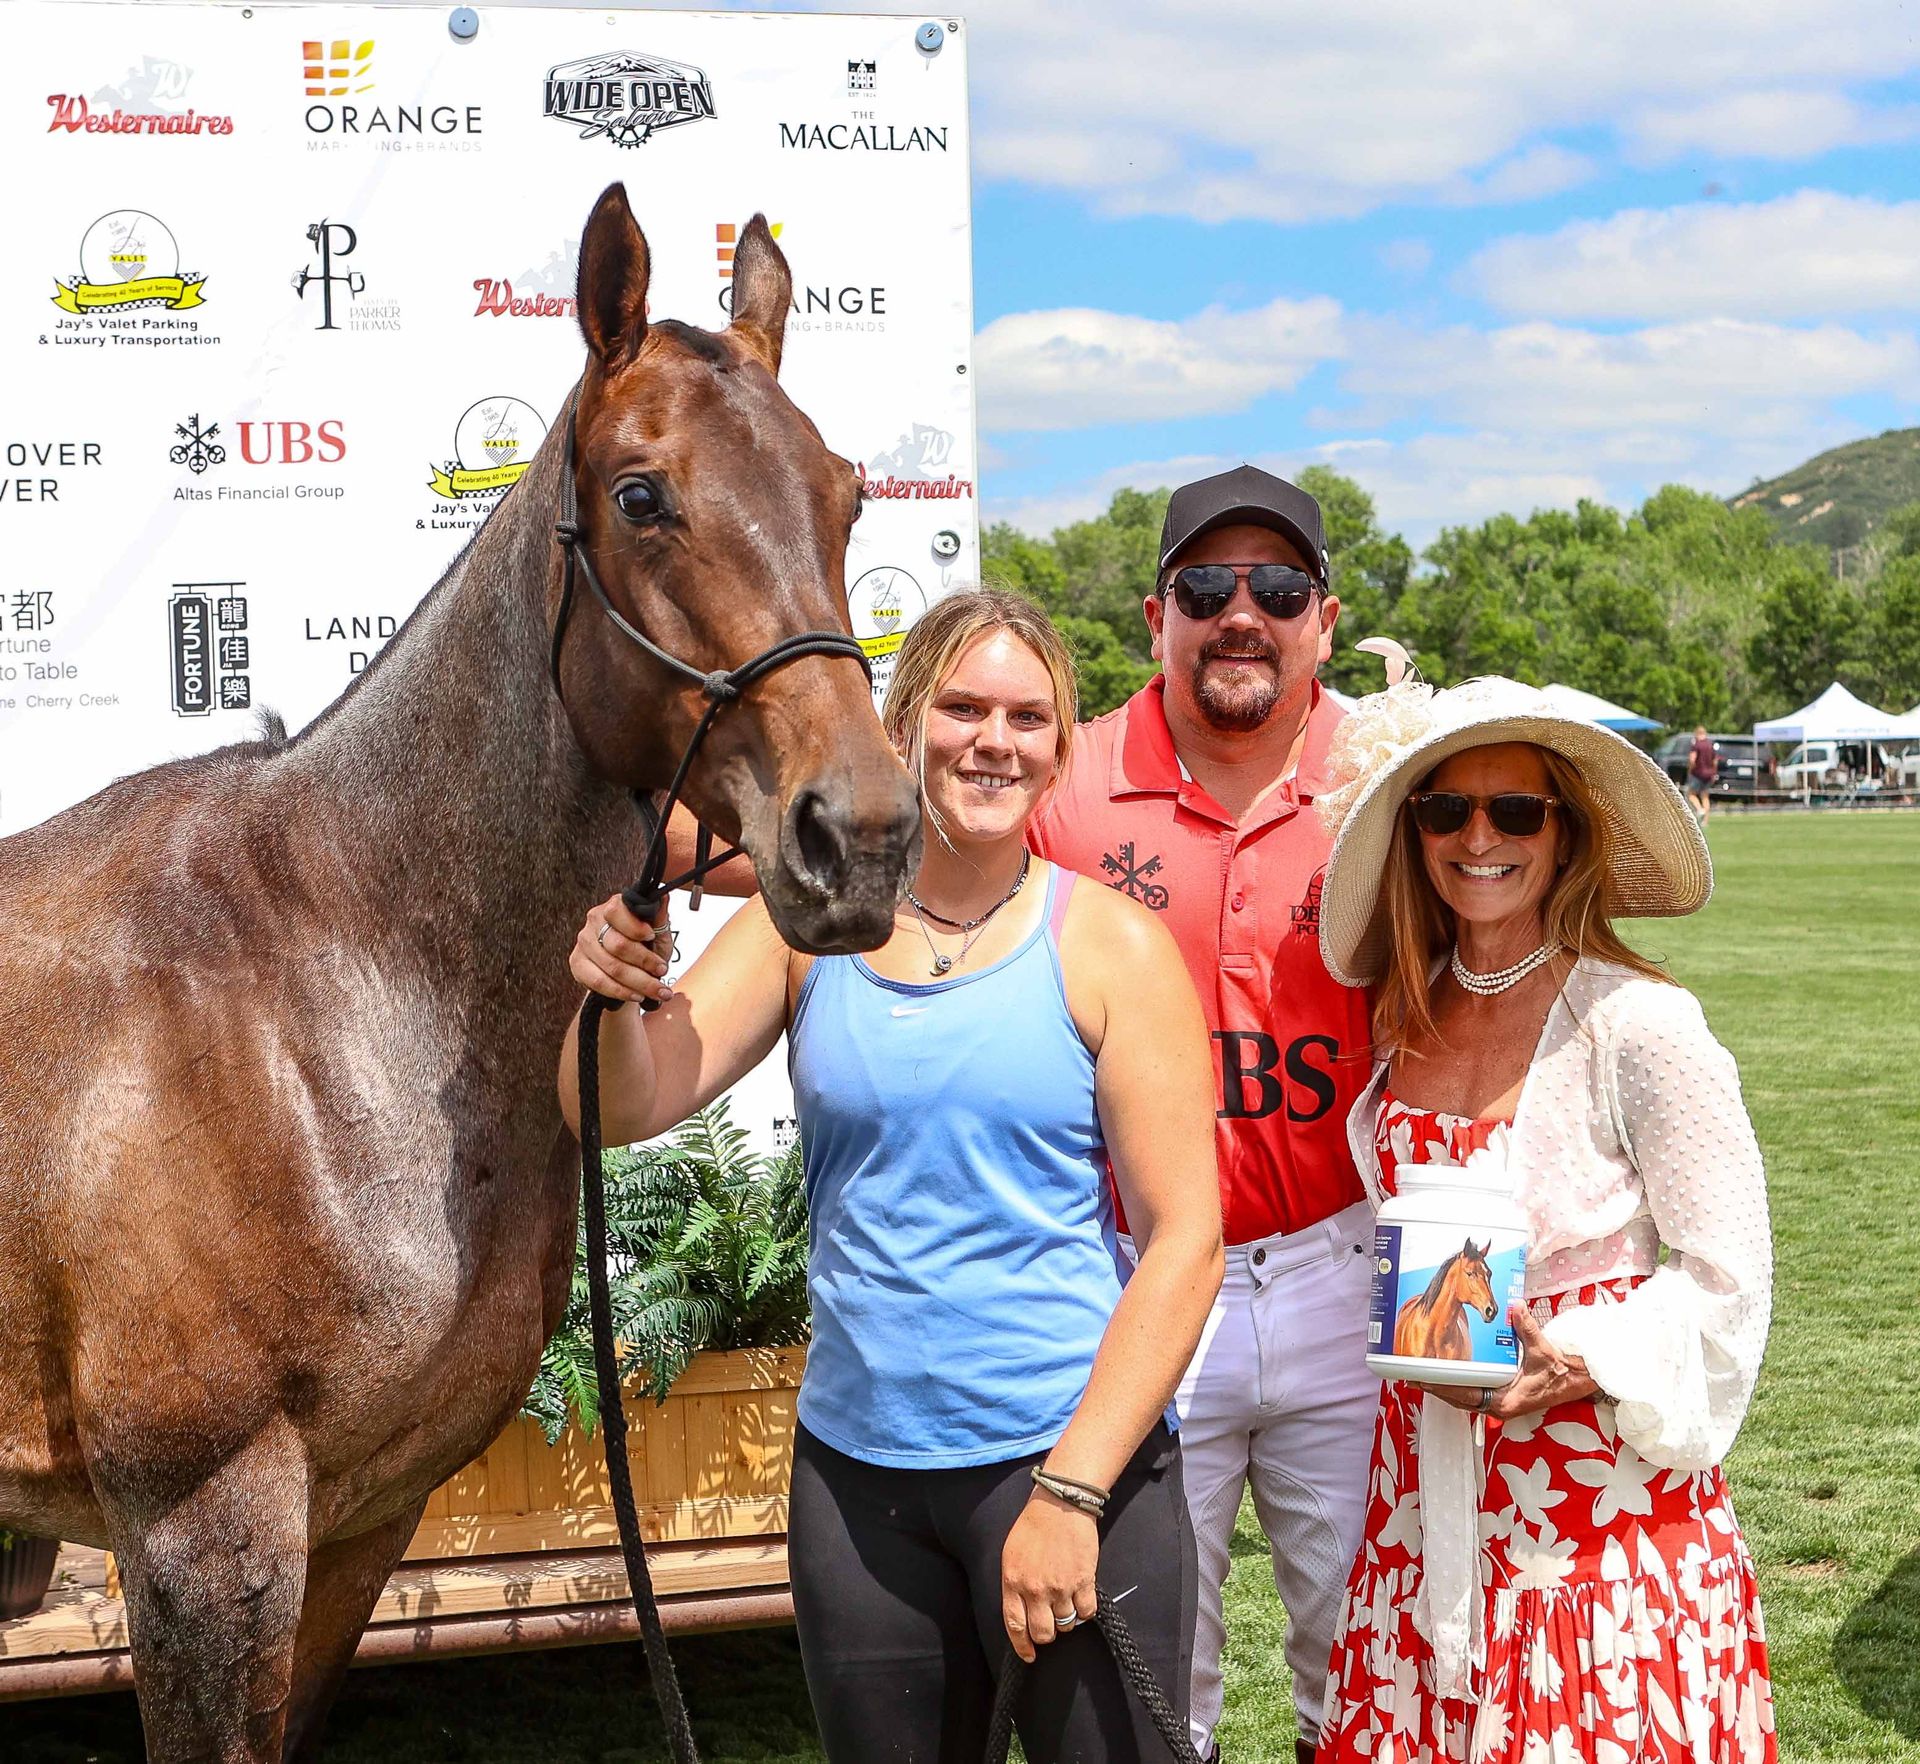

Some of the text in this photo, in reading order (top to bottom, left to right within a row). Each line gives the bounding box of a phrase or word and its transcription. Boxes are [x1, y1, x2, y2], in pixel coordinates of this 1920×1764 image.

[543, 80, 717, 118] WIDE OPEN
[46, 94, 233, 134] Westernaires
[305, 105, 482, 134] ORANGE
[580, 104, 678, 139] Saloon
[851, 111, 875, 119] THE
[779, 122, 948, 152] MACALLAN
[155, 283, 177, 291] Service
[350, 306, 401, 319] PARKER
[56, 319, 198, 331] Jay's Valet Parking
[349, 320, 401, 331] THOMAS
[38, 335, 220, 347] & Luxury Transportation
[236, 420, 346, 464] UBS
[7, 443, 102, 466] OVER
[457, 475, 491, 483] Celebrating
[501, 471, 517, 479] Years
[174, 485, 344, 500] Altas Financial Group
[432, 503, 468, 515] Jay's
[416, 520, 425, 529] &
[305, 616, 397, 640] LAND
[181, 604, 203, 705] FORTUNE
[23, 662, 78, 680] Table
[26, 695, 73, 710] Cherry
[79, 693, 120, 706] Creek
